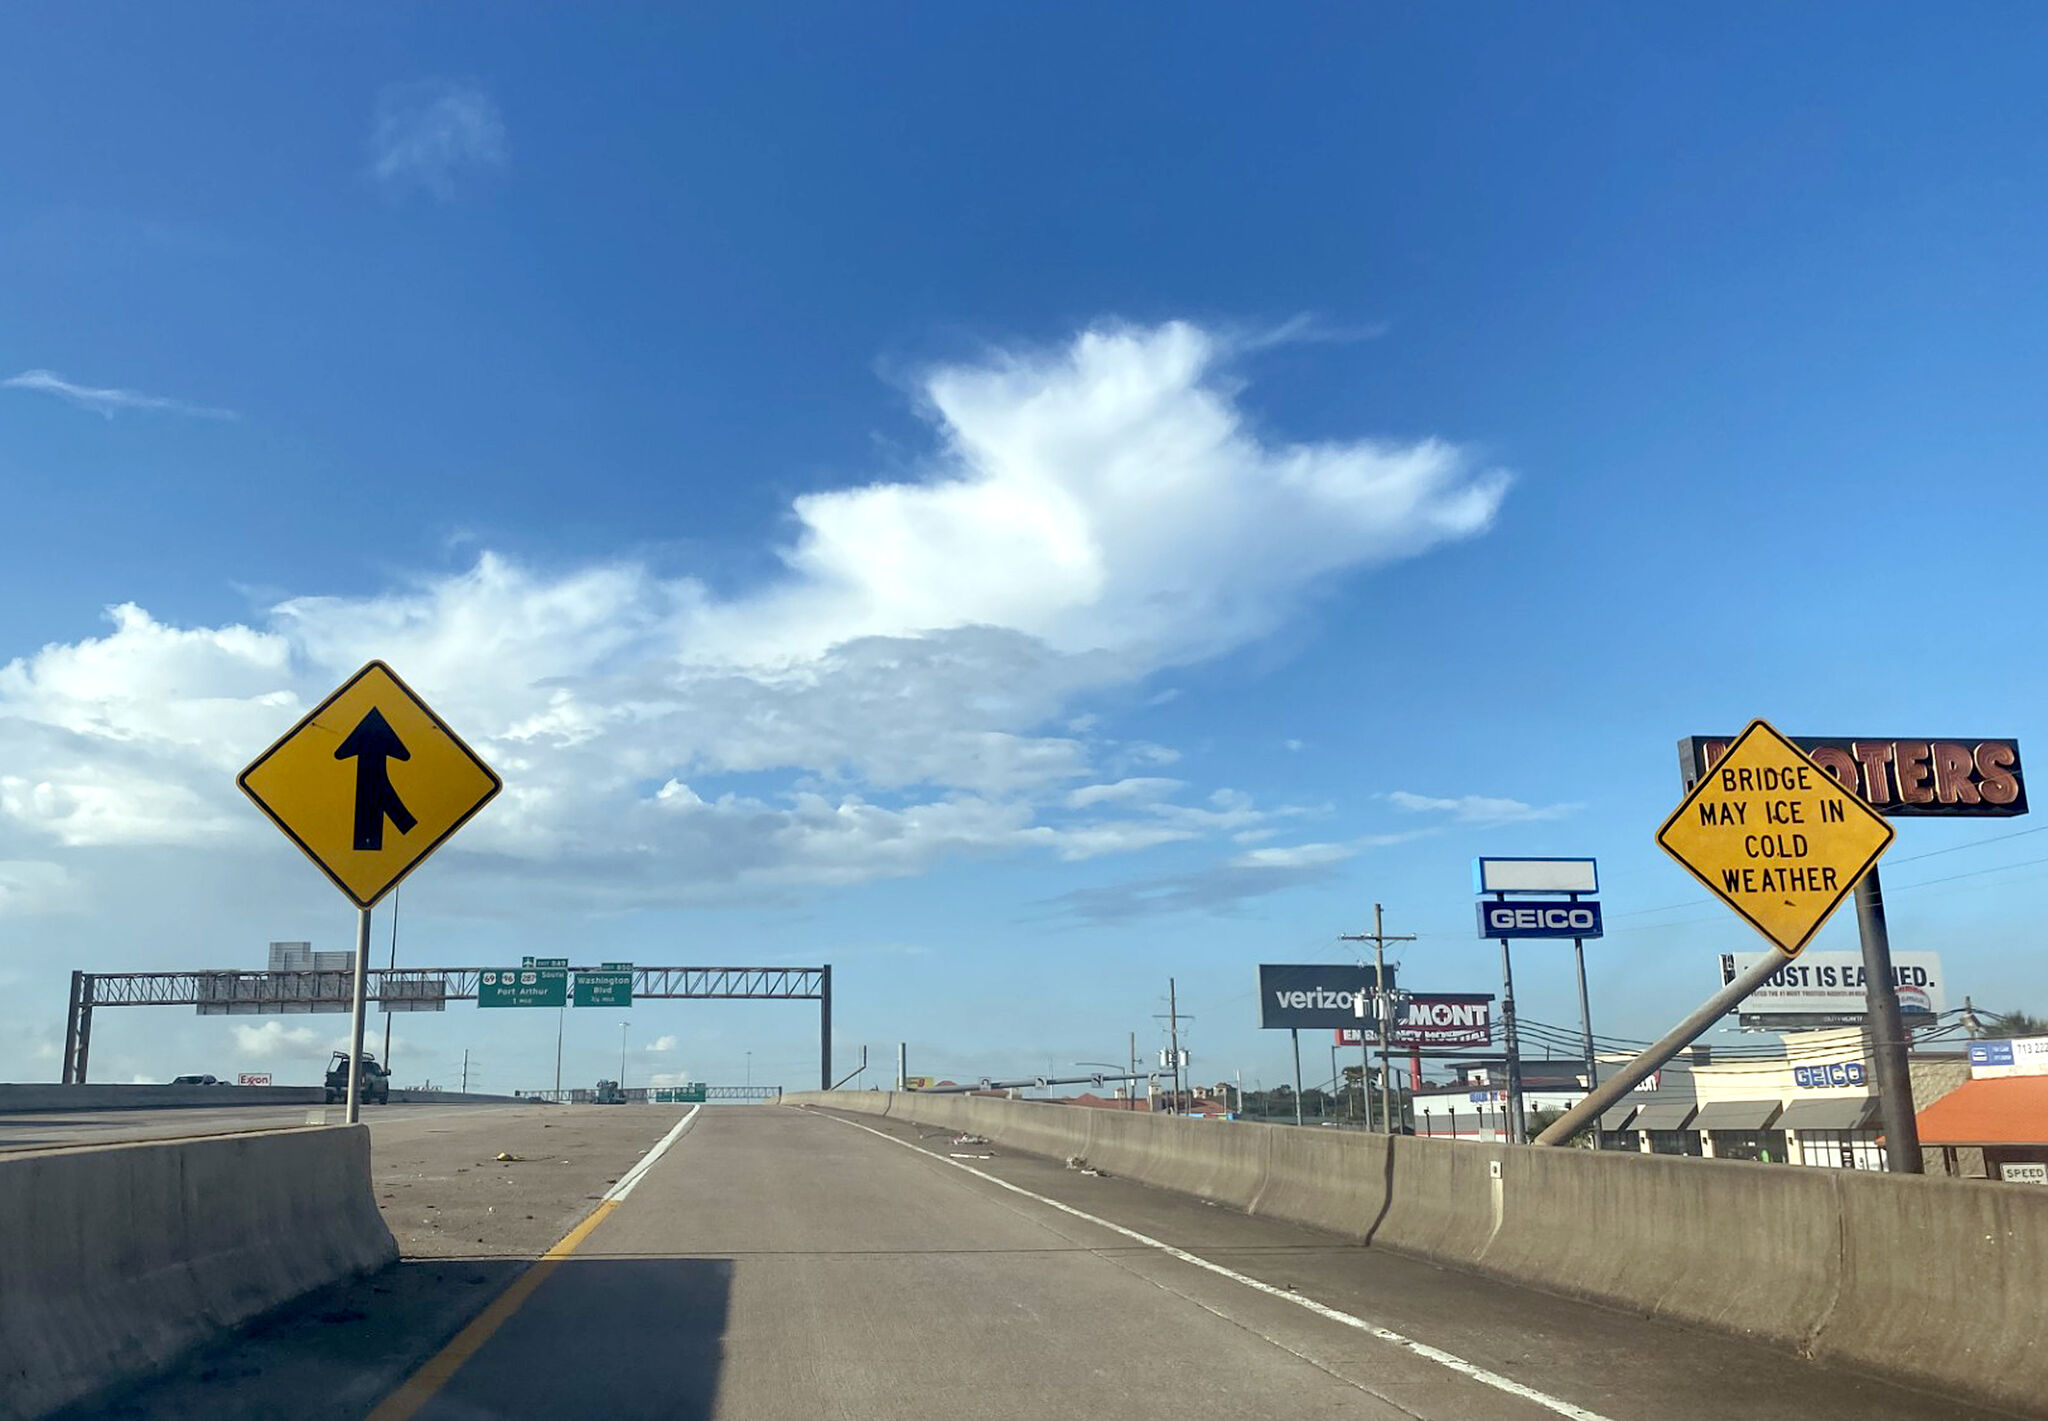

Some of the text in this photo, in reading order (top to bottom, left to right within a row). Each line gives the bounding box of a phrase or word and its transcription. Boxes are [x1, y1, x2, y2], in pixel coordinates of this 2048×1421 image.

[1703, 742, 2019, 804] OTERS
[1722, 766, 1812, 792] BRIDGE
[1699, 799, 1845, 826] MAY ICE IN
[1745, 834, 1808, 858] COLD
[1722, 867, 1838, 893] WEATHER
[1490, 909, 1594, 929] GEICO
[484, 975, 496, 984] 69
[503, 975, 514, 983] 96
[521, 974, 536, 984] 287
[577, 977, 630, 986] Washington
[1744, 966, 1936, 988] UST IS EAED.
[497, 987, 549, 996] Port Arthur
[1276, 986, 1353, 1009] verizo
[1399, 1004, 1488, 1026] MONT
[1794, 1063, 1868, 1087] GEICO
[2006, 1168, 2045, 1178] SPEED
